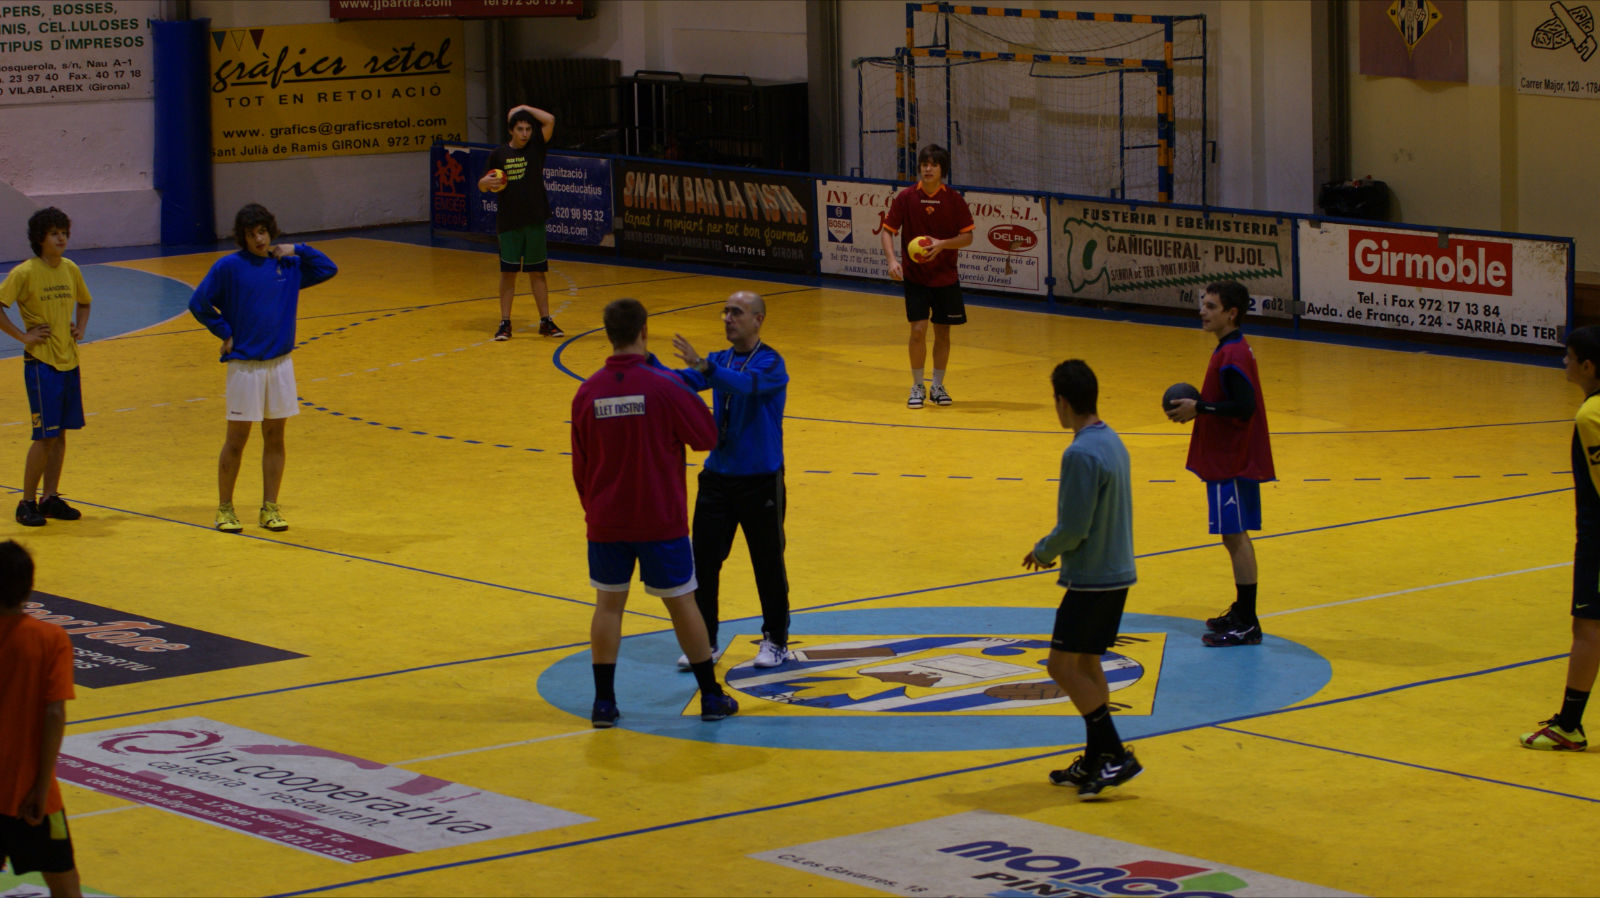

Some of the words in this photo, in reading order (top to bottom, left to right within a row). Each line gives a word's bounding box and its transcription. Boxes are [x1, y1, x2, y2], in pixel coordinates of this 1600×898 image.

[0, 5, 45, 17] PERS,
[53, 2, 118, 15] BOSSES,
[0, 23, 31, 35] NIS,
[38, 18, 139, 33] CEL.LULOSES
[363, 38, 453, 73] rètol
[0, 62, 57, 72] osquerola,
[113, 59, 132, 67] A-1
[9, 75, 22, 83] 23
[27, 74, 40, 82] 97
[45, 73, 59, 81] 40
[95, 71, 109, 79] 40
[130, 69, 142, 78] 18
[9, 83, 84, 95] VILABLAREIX
[88, 82, 130, 92] (Girona)
[1520, 77, 1543, 89] Carrer
[1544, 78, 1566, 94] Major,
[1567, 80, 1580, 92] 120
[225, 96, 265, 108] TOT
[279, 94, 304, 105] EN
[241, 143, 269, 156] Julià
[272, 143, 288, 154] de
[291, 140, 328, 153] Ramis
[332, 138, 380, 151] GIRONA
[387, 136, 409, 146] 972
[414, 135, 426, 144] 17
[542, 167, 583, 179] rganització
[623, 170, 682, 212] SNACK
[682, 175, 720, 217] BAR
[717, 178, 747, 220] LA
[743, 181, 808, 226] PISTA
[555, 206, 571, 219] 620
[582, 208, 593, 221] 95
[594, 210, 604, 222] 32
[967, 202, 1005, 219] CIOS,
[1010, 206, 1038, 221] S.L.
[656, 214, 660, 228] i
[724, 221, 739, 236] tot
[743, 226, 761, 239] bon
[828, 219, 851, 229] BOSCH
[1082, 207, 1157, 226] FUSTERIA
[1164, 215, 1169, 226] I
[1176, 216, 1279, 237] EBENISTERIA
[993, 231, 1032, 245] DELPHI
[1106, 233, 1202, 261] CAÑIGUERAL
[1214, 244, 1266, 267] PUJOL
[983, 264, 1018, 275] d'equs
[1143, 265, 1155, 278] TER
[1354, 237, 1507, 288] Girmoble
[987, 275, 1012, 285] Diesel
[1357, 291, 1379, 306] Tel.
[1383, 293, 1387, 306] i
[1391, 294, 1414, 309] Fax
[1418, 297, 1442, 312] 972
[1447, 301, 1460, 313] 17
[1465, 302, 1479, 315] 13
[1483, 304, 1500, 317] 84
[1306, 302, 1342, 318] Avda.
[1346, 305, 1361, 319] de
[1366, 307, 1415, 327] França,
[1418, 313, 1443, 328] 224
[1510, 324, 1528, 338] DE
[1533, 325, 1556, 341] TER
[147, 760, 247, 789] cafeteria
[260, 790, 391, 827] restaurant
[184, 750, 239, 766] la
[233, 765, 493, 835] cooperativa
[202, 800, 257, 816] 17840
[250, 813, 305, 829] Sarrià
[299, 827, 325, 836] de
[321, 833, 355, 843] Ter
[936, 840, 1236, 898] monc
